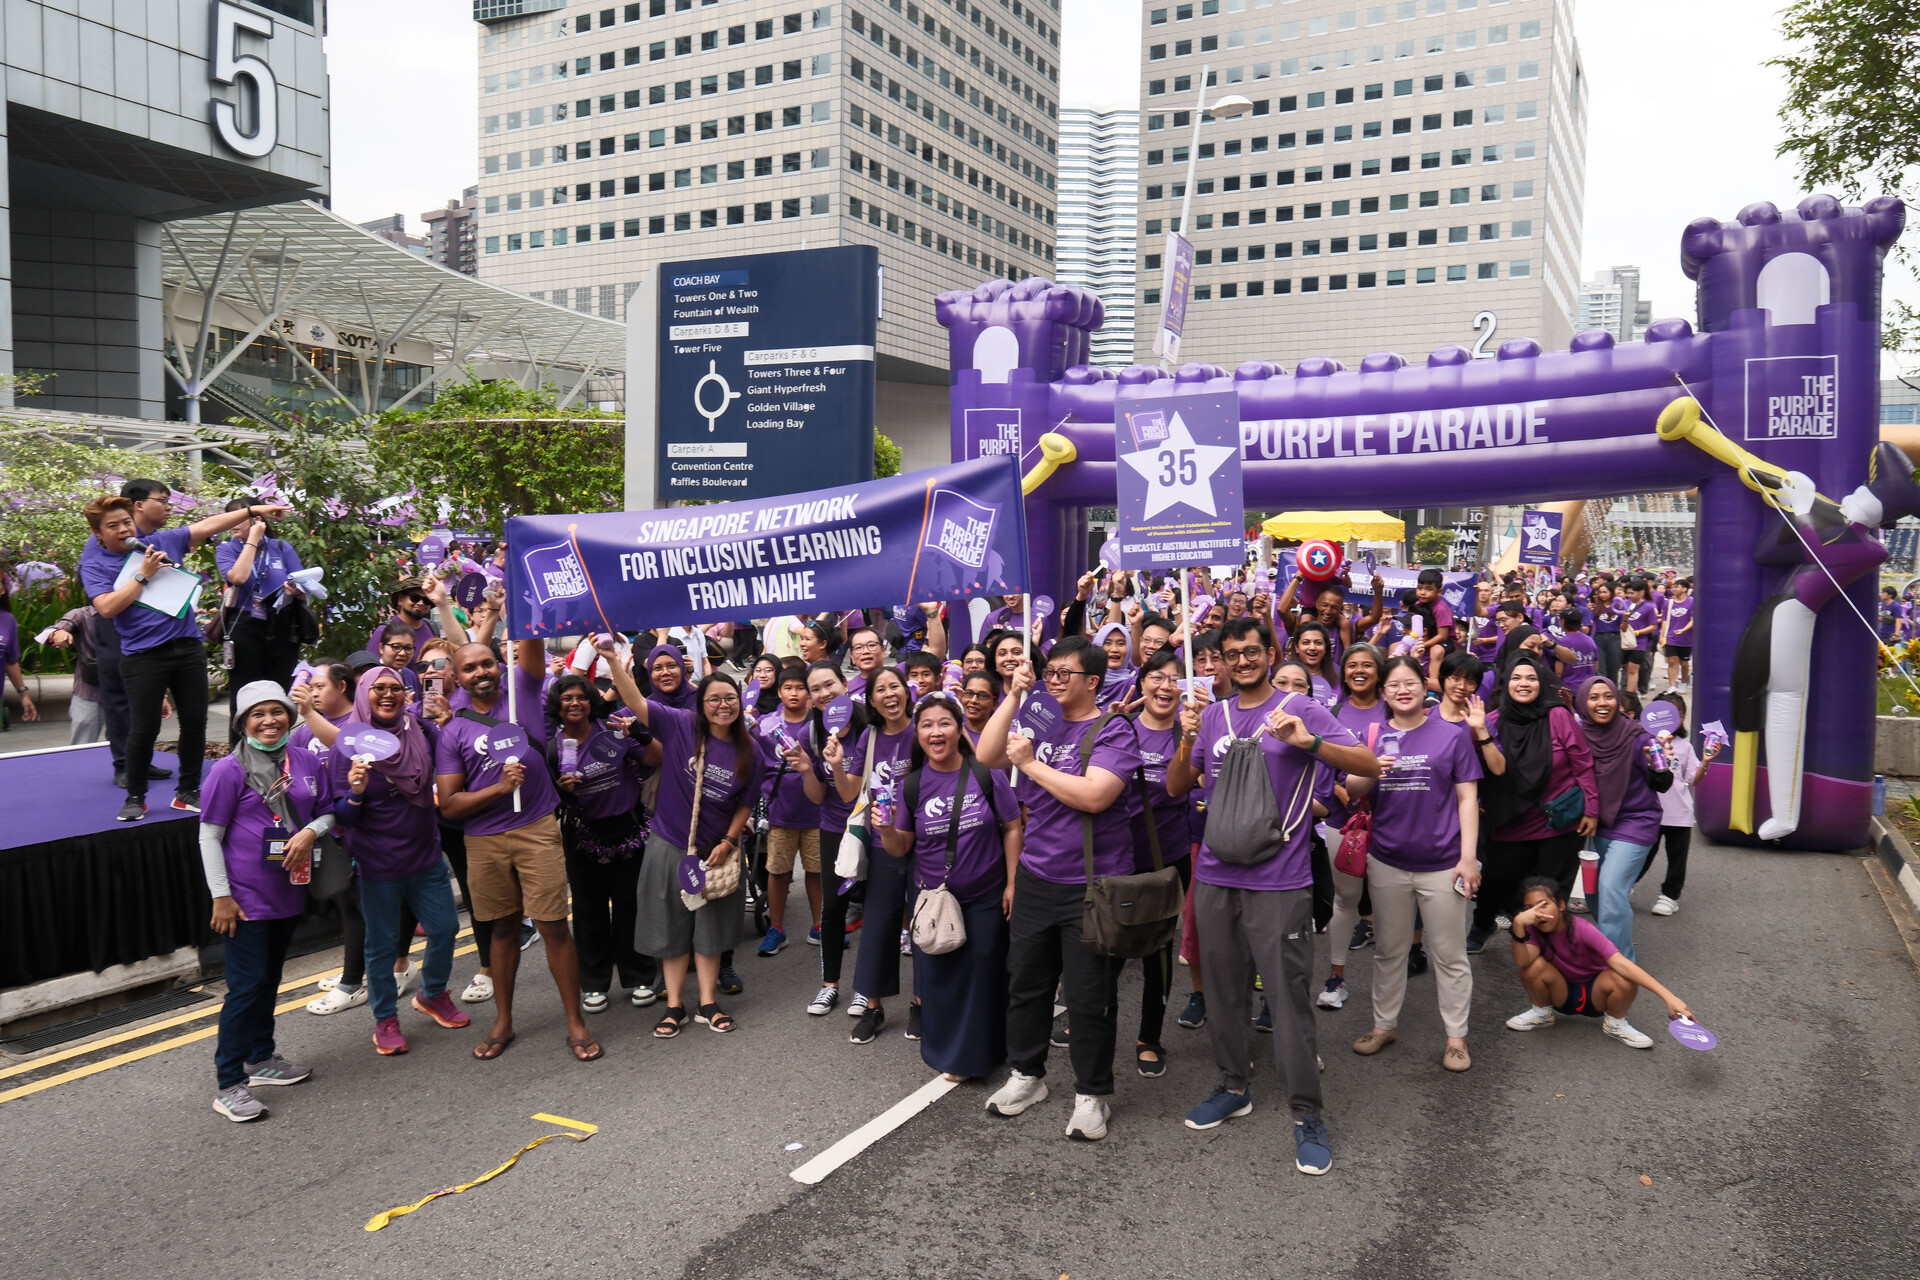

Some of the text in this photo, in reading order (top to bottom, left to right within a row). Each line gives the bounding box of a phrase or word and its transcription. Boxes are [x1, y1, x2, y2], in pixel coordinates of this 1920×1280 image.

[208, 0, 279, 159] 5
[673, 274, 720, 287] COACH BAY
[674, 289, 758, 303] Towers One & Two
[673, 304, 759, 318] Fountain of Wealth
[673, 323, 738, 337] Carparks D & E
[1471, 310, 1498, 359] 2
[673, 343, 722, 354] Tower Five
[748, 349, 817, 363] Carparks F & G
[748, 366, 847, 379] Towers Three & Four
[747, 383, 827, 395] Giant Hyperfresh
[1801, 374, 1834, 396] THE
[747, 401, 816, 412] Golden Village
[1768, 395, 1834, 416] PURPLE
[746, 418, 805, 430] Loading Bay
[996, 423, 1019, 440] THE
[1240, 400, 1549, 461] PURPLE PARADE
[1768, 415, 1834, 437] PARADE
[671, 444, 714, 455] Carpark A
[979, 439, 1020, 455] PURPLE
[671, 461, 754, 471] Convention Centre
[1158, 448, 1197, 487] 35
[670, 477, 748, 487] Raffles Boulevard
[637, 493, 859, 544] SINGAPORE NETWORK
[967, 516, 989, 537] THE
[942, 518, 986, 551] PURPLE
[1534, 528, 1548, 540] 36
[619, 525, 882, 582] FOR INCLUSIVE LEARNING
[939, 533, 983, 565] PARADE
[1123, 538, 1241, 553] NEWCASTLE AUSTRALIA INSTITUTE OF
[556, 553, 577, 571] THE
[1151, 550, 1213, 562] HIGHER EDUCATION
[543, 565, 583, 585] PURPLE
[547, 579, 586, 597] PARADE
[687, 570, 816, 611] FROM NAIHE
